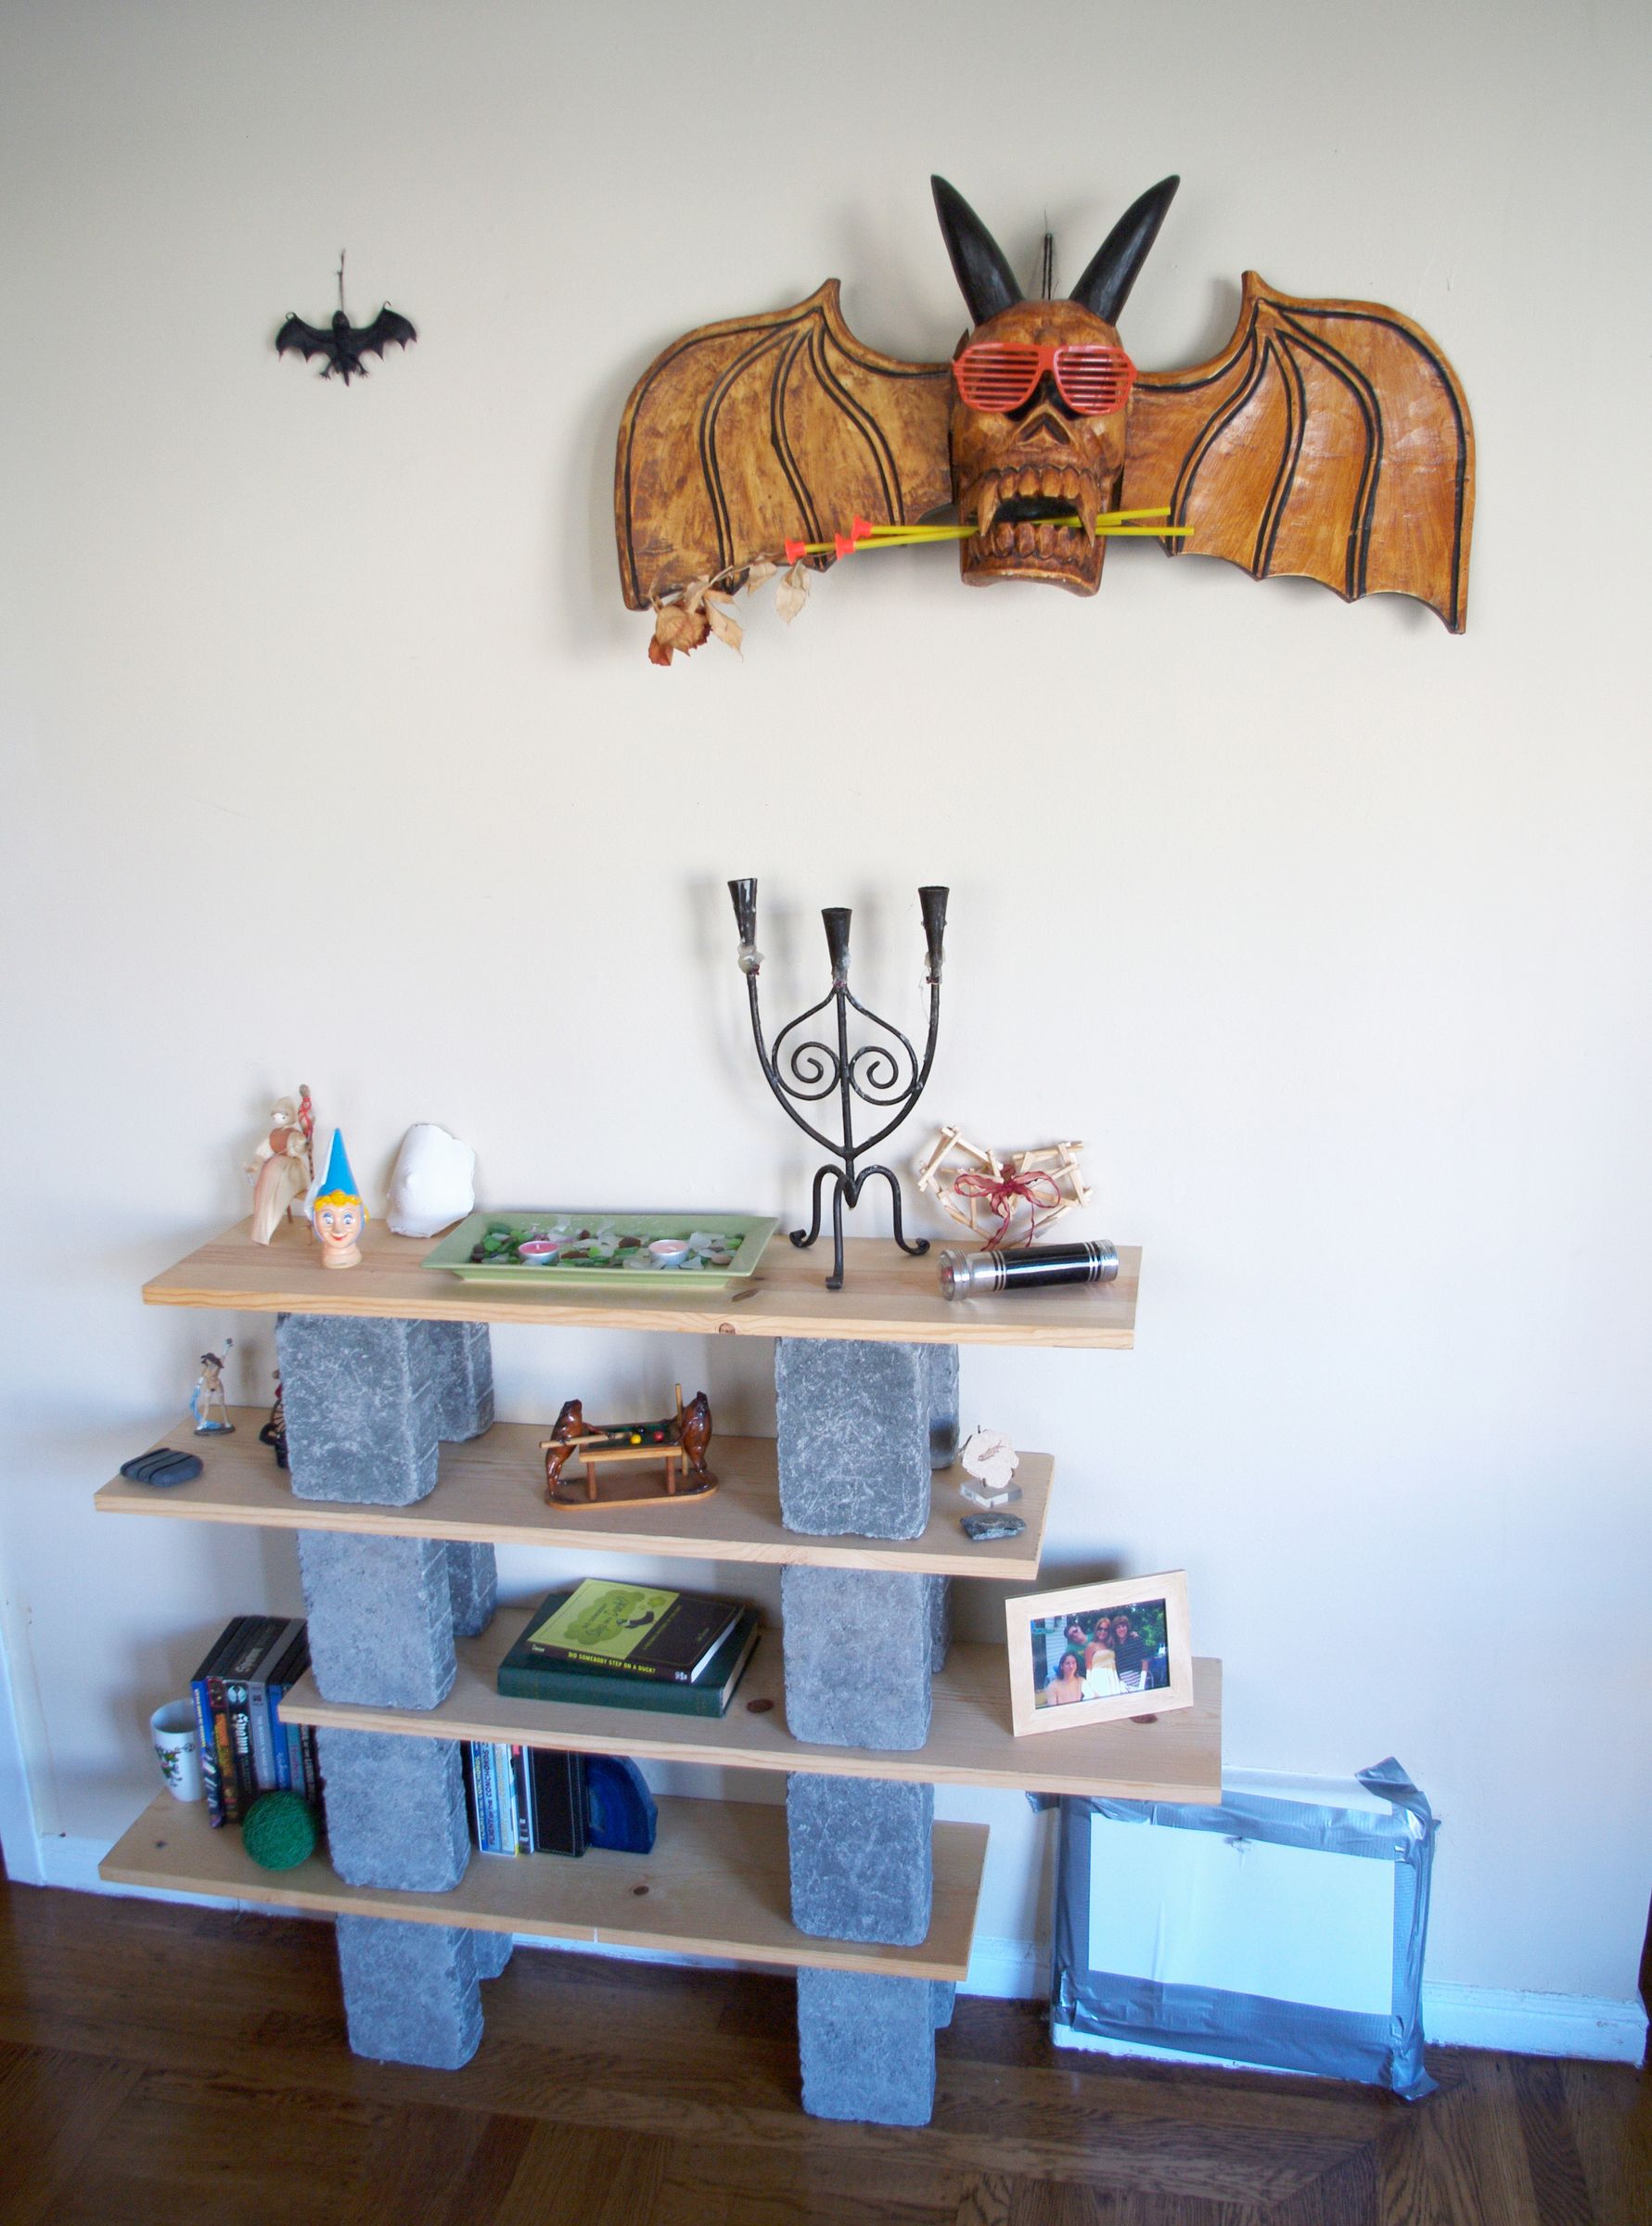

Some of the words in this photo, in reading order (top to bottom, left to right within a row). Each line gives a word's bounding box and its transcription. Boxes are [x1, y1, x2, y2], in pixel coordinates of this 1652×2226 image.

[579, 1654, 608, 1665] SOMEBODY
[638, 1666, 656, 1674] DUCK?
[482, 1750, 493, 1797] CONCHORDS
